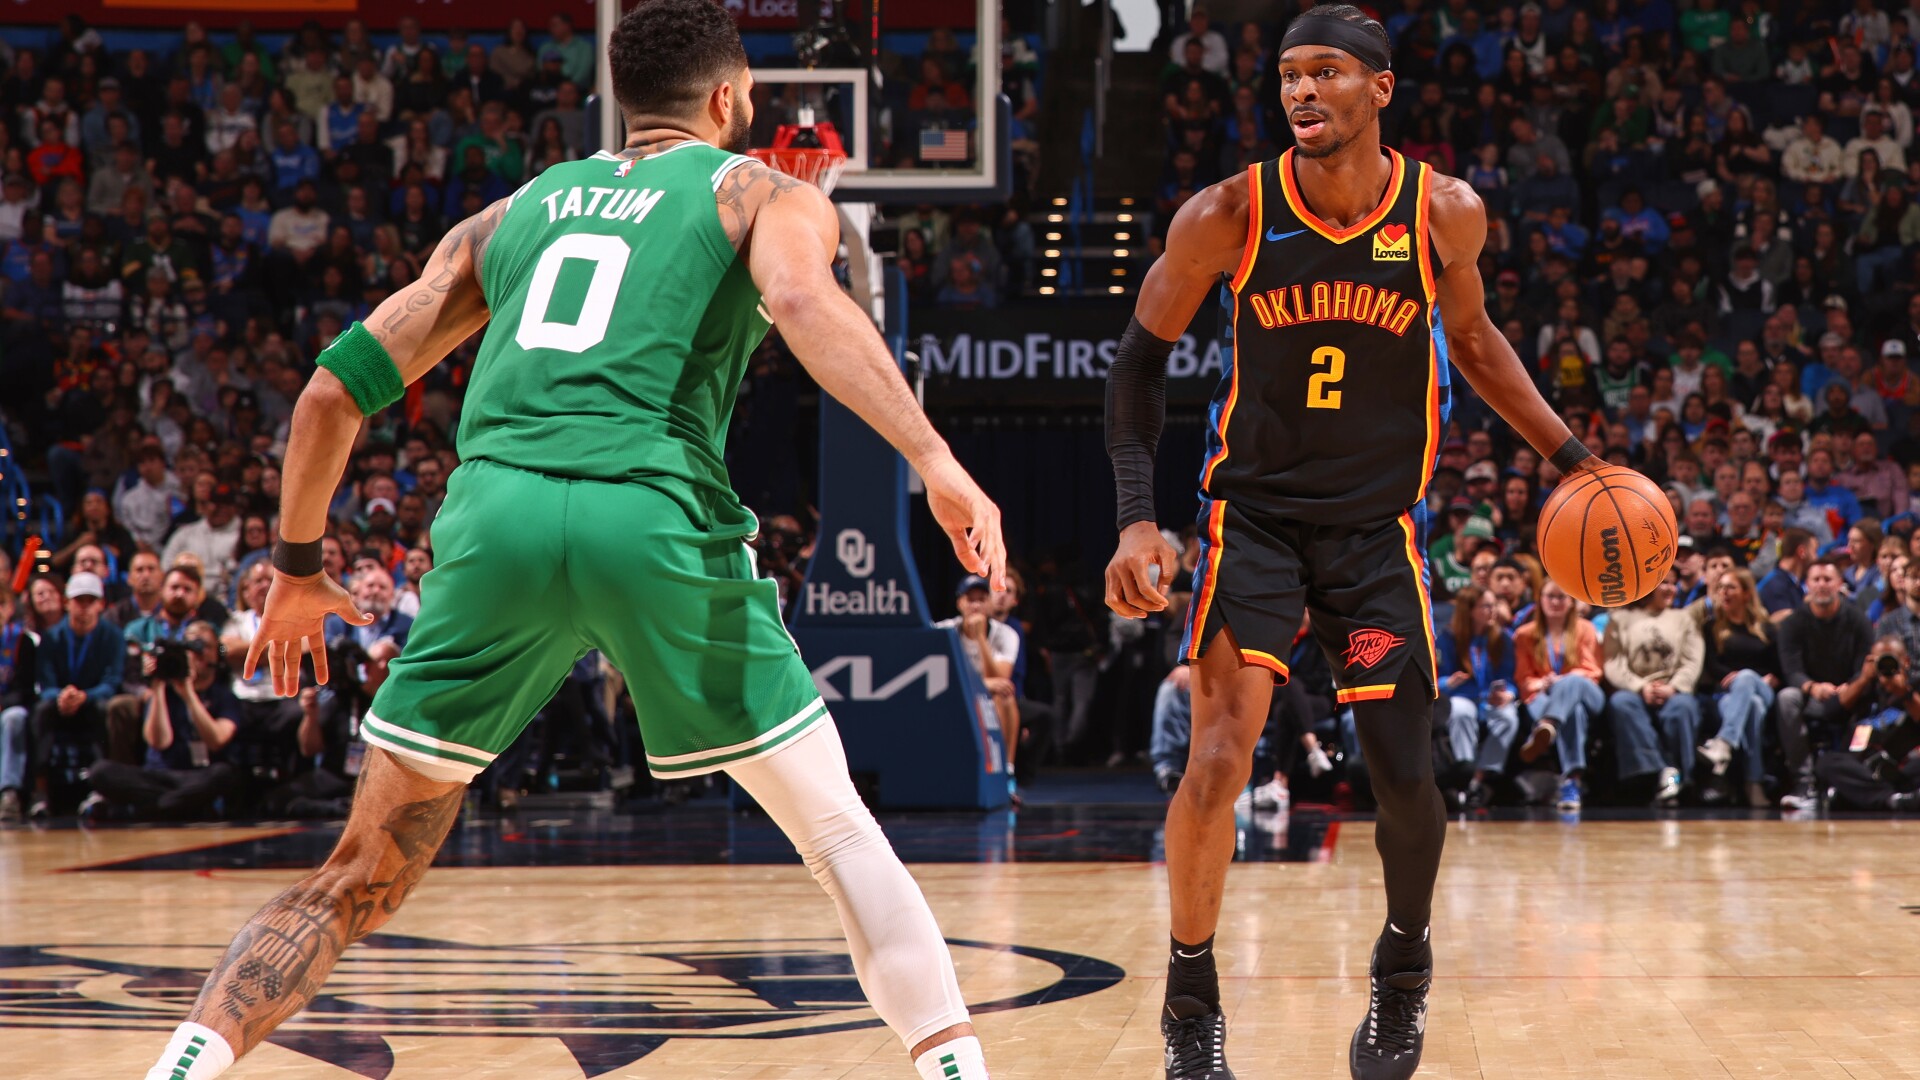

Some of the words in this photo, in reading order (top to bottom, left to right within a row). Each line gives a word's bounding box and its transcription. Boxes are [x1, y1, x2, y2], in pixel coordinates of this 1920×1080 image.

[541, 186, 666, 224] TATUM
[515, 233, 631, 353] 0
[1250, 281, 1420, 337] OKLAHOMA
[922, 333, 1117, 379] MIDFIRS
[1166, 333, 1222, 378] BA
[1306, 345, 1345, 410] 2
[1597, 526, 1628, 605] Wilson
[805, 578, 910, 615] Health
[1350, 636, 1383, 659] OKC
